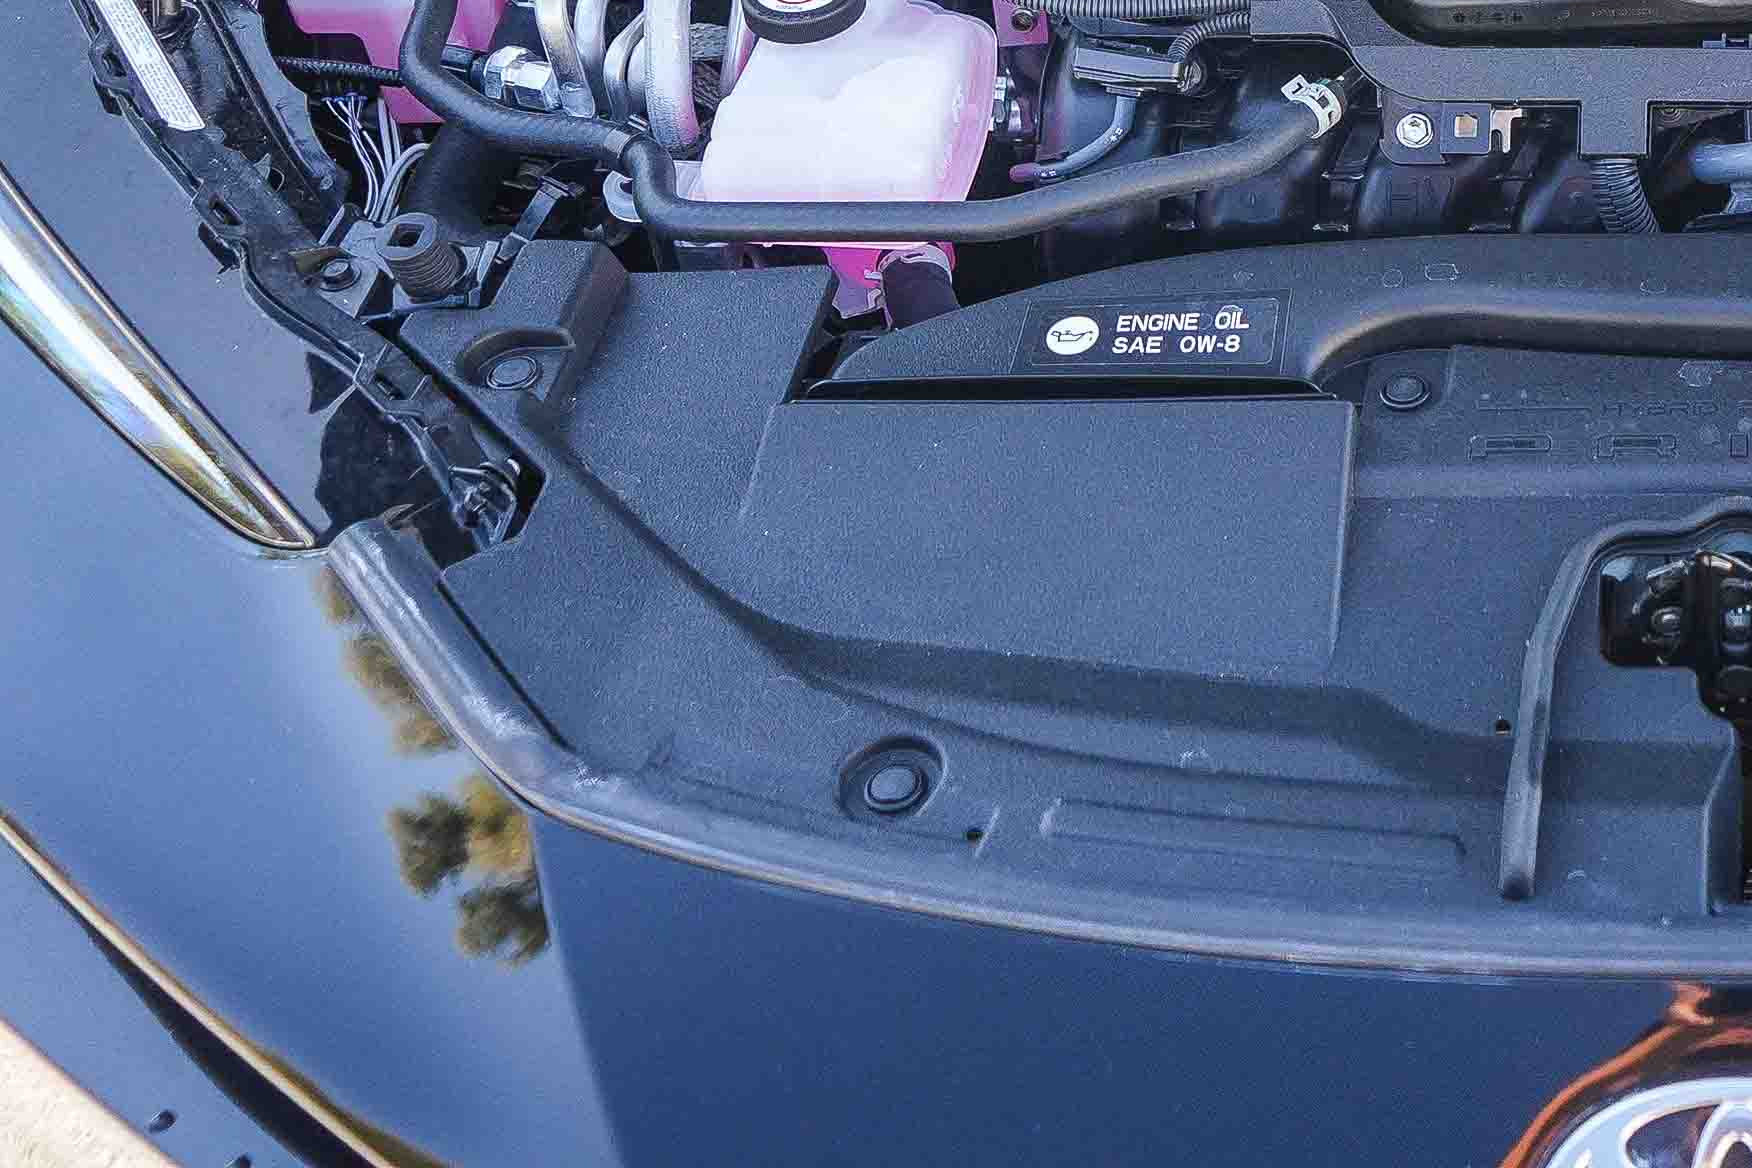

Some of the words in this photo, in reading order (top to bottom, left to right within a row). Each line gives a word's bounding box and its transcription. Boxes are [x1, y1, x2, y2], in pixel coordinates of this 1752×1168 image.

[1116, 313, 1200, 333] ENGINE
[1214, 310, 1250, 331] OIL
[1111, 335, 1162, 355] SAE
[1600, 399, 1720, 417] HYBRID
